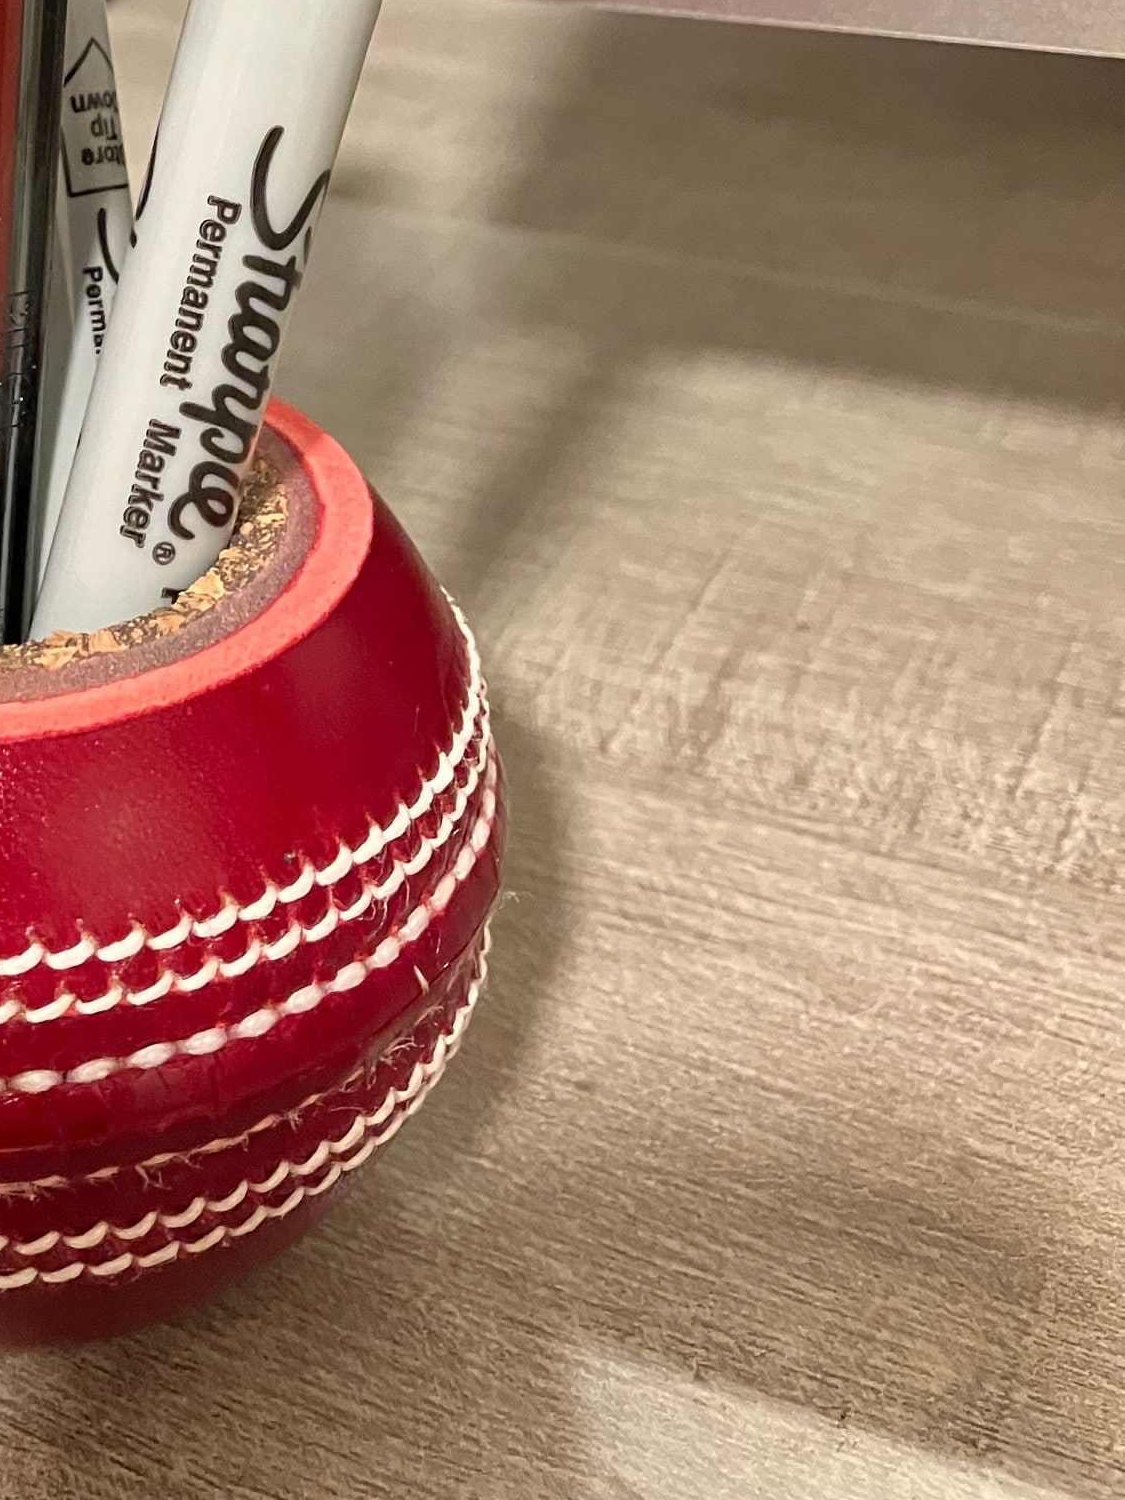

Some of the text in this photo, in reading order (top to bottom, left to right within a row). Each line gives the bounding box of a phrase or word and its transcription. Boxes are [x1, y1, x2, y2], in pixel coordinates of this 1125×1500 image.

[70, 90, 119, 114] own
[82, 266, 107, 354] Perma
[119, 196, 242, 549] Permanent Marker
